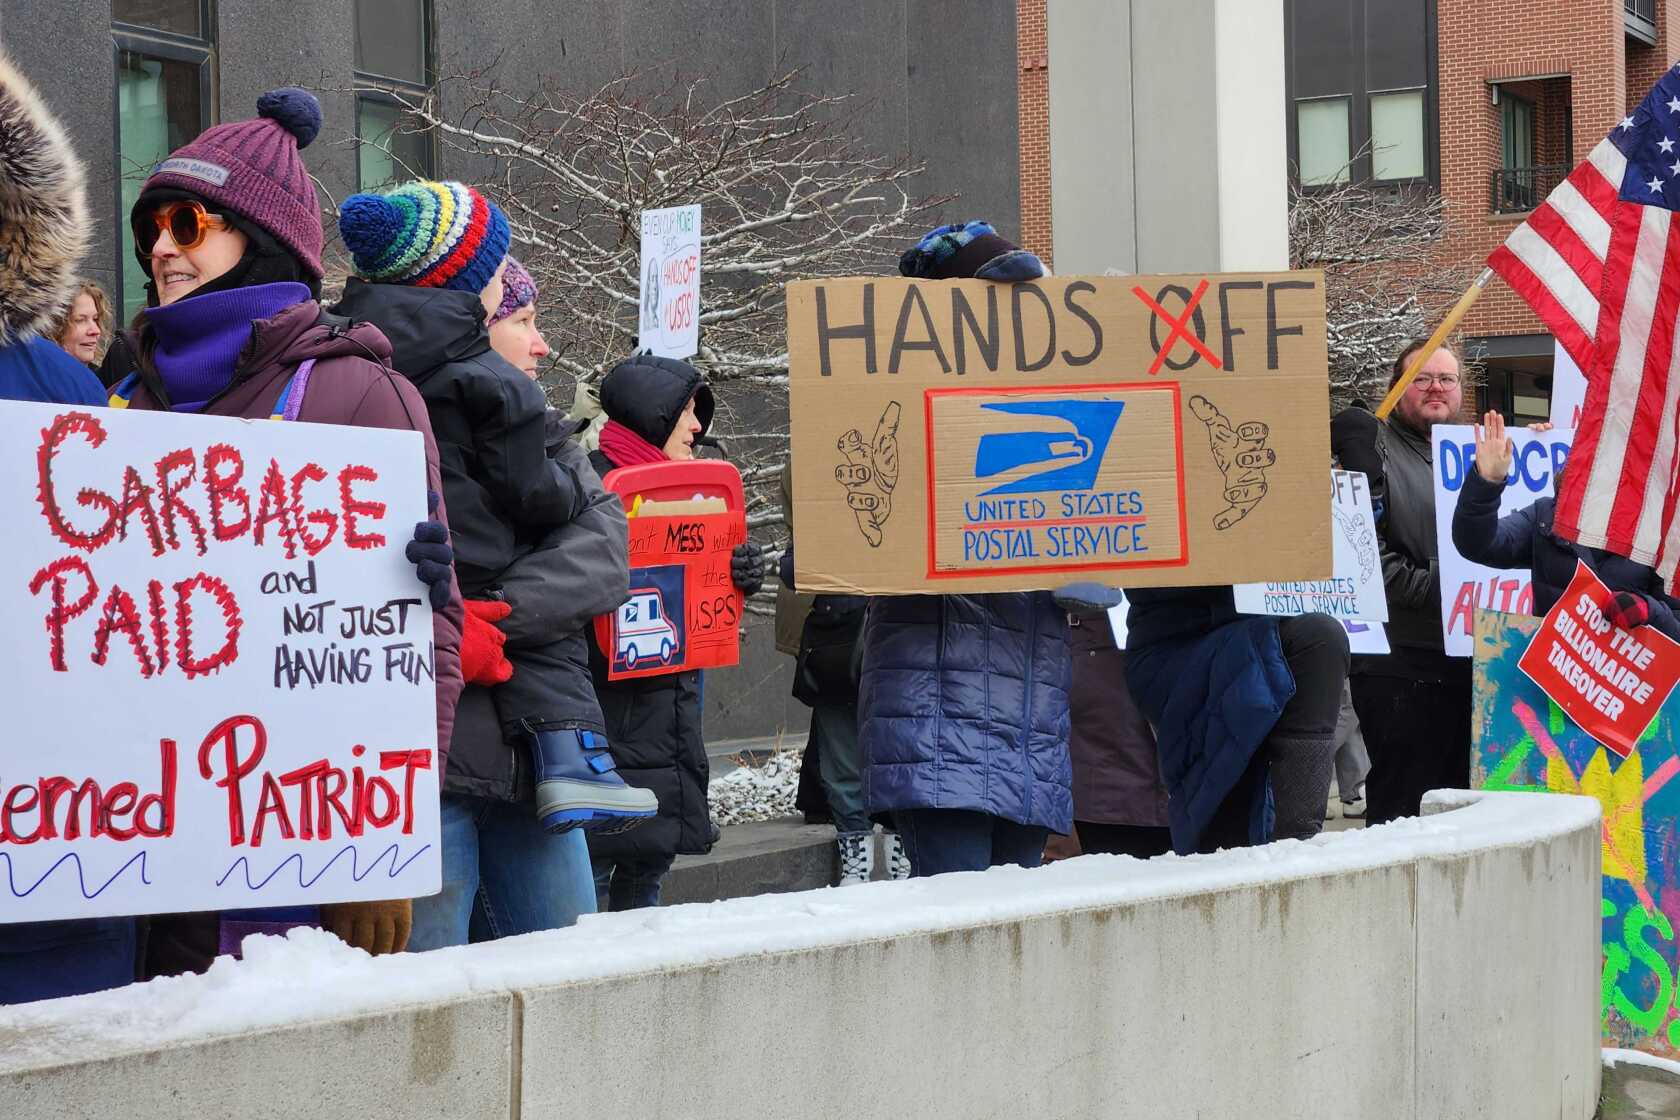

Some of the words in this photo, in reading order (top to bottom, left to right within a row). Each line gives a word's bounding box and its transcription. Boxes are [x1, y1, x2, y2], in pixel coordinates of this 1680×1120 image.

[190, 162, 224, 180] DAKOTA
[663, 258, 682, 287] HANDS
[683, 256, 697, 290] OFF
[815, 281, 1104, 376] HANDS
[1149, 281, 1316, 371] OFF
[36, 410, 387, 559] GARBAGE
[1331, 471, 1363, 505] FF
[965, 498, 1046, 522] UNITED
[1061, 491, 1144, 517] STATES
[628, 520, 657, 551] on't
[663, 522, 705, 553] MESS
[964, 528, 1040, 561] POSTAL
[1046, 523, 1149, 557] SERVICE
[260, 560, 318, 595] and
[702, 560, 728, 587] the
[1309, 577, 1355, 594] STATES
[29, 554, 244, 679] PAID
[283, 600, 336, 637] NOT
[340, 598, 422, 640] JUST
[1264, 594, 1306, 613] POSTAL
[1311, 594, 1360, 615] SERVICE
[1575, 592, 1612, 637] STOP
[1609, 626, 1656, 671] THE
[383, 640, 435, 687] FUN
[1553, 608, 1655, 705] BILLIONAIRE
[1547, 640, 1625, 722] TAKEOVER
[0, 738, 178, 846] erned
